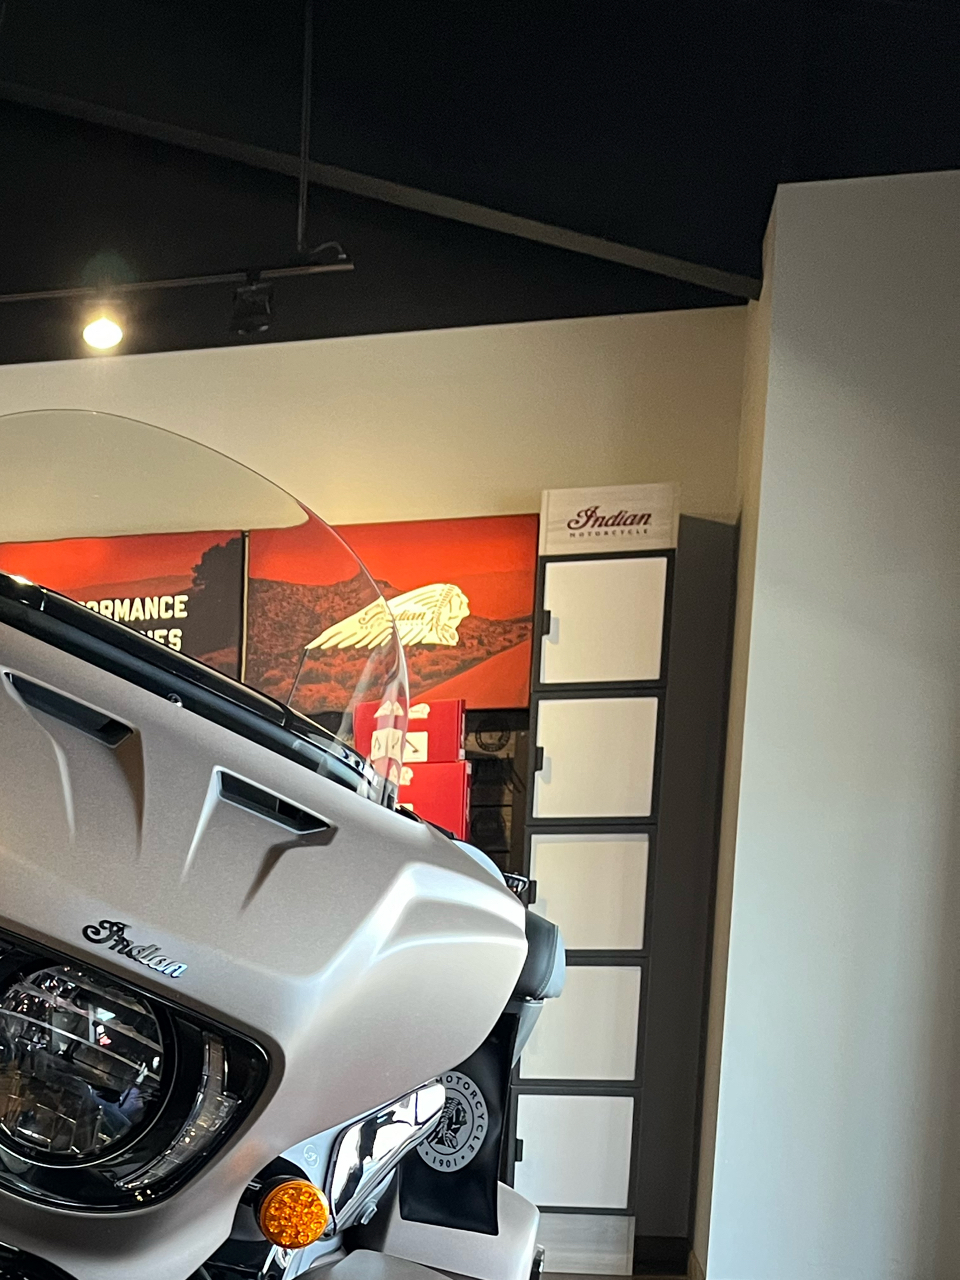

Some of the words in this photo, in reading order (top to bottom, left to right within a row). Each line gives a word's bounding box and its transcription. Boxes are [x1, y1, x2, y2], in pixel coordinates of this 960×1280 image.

[566, 505, 652, 530] Indian
[569, 528, 648, 538] MOTORCYCLE
[82, 919, 188, 979] Indian
[432, 1156, 458, 1169] 1901
